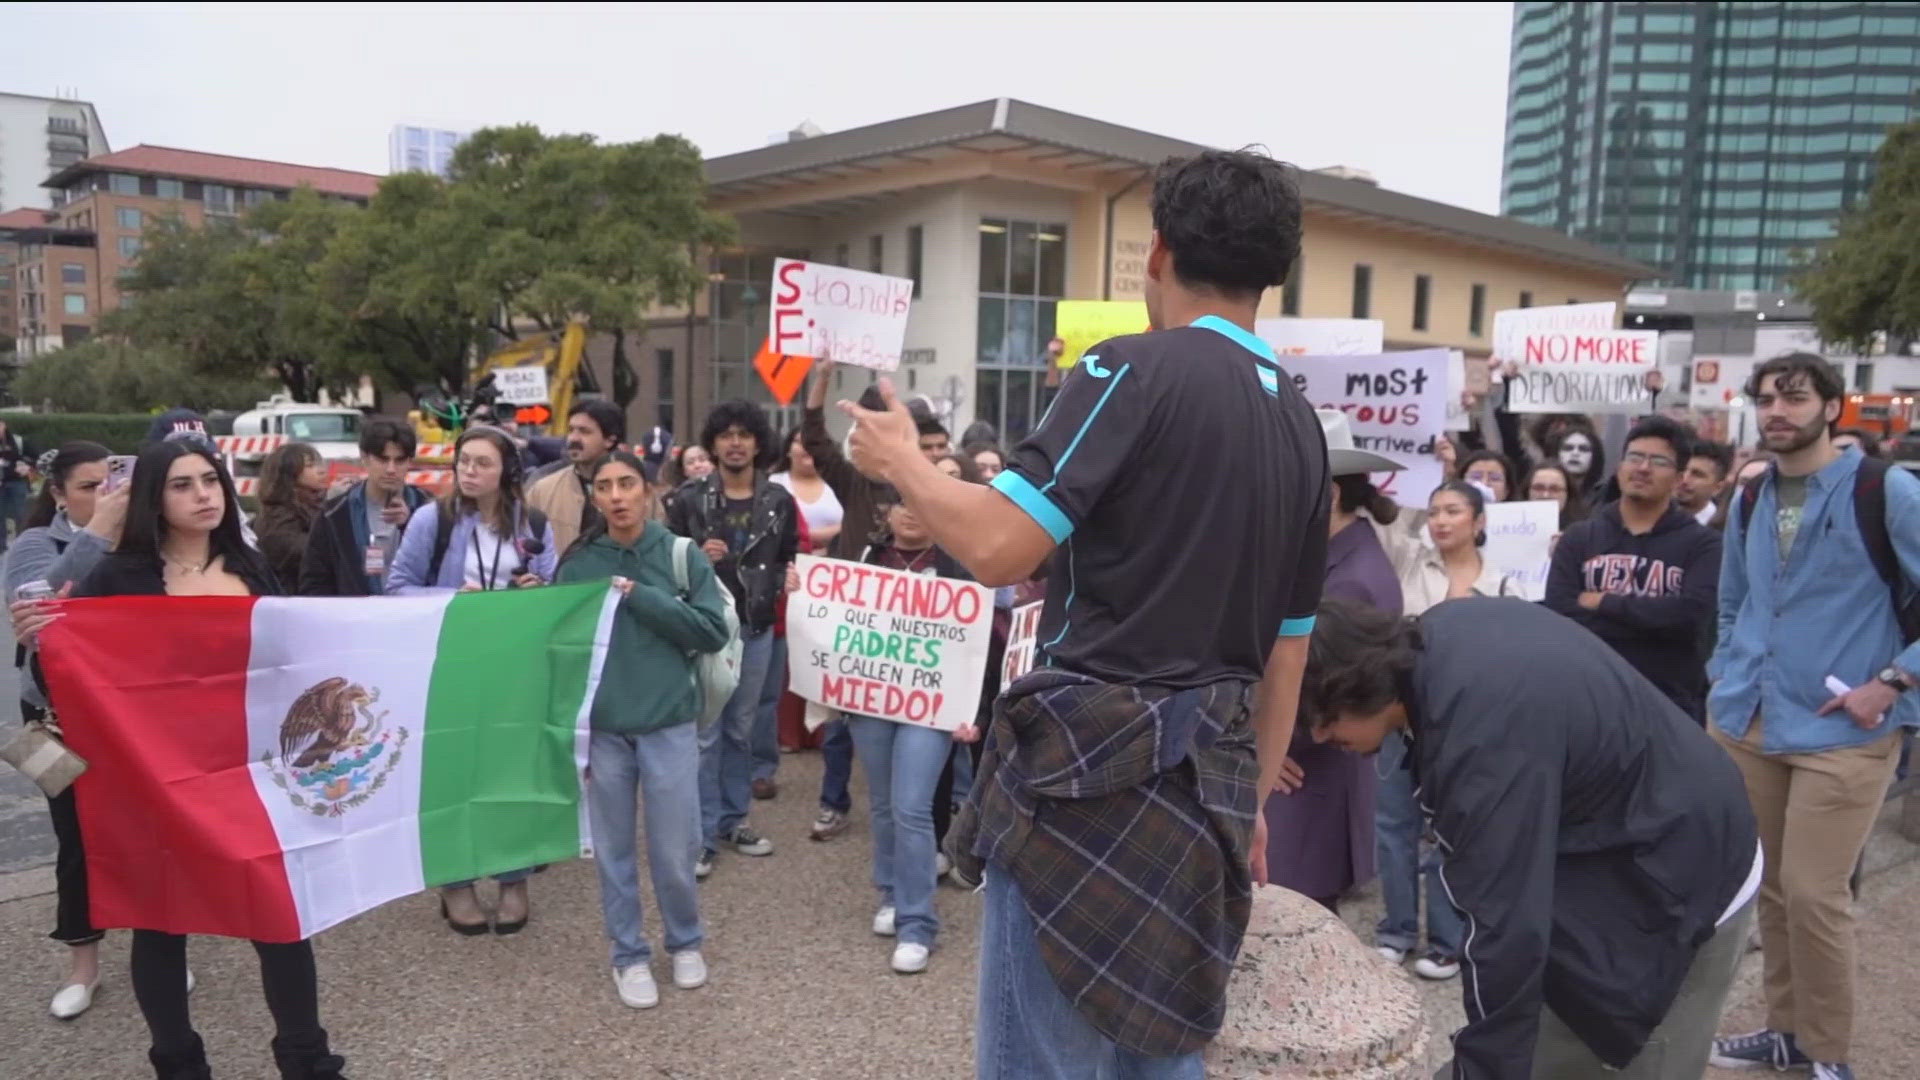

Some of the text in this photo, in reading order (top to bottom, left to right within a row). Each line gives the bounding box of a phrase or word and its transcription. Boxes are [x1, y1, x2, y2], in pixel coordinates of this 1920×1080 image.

[1526, 334, 1648, 365] NO MORE
[504, 386, 544, 399] LOSED
[806, 562, 981, 625] GRITANDO
[1581, 552, 1685, 598] TEXAS
[808, 603, 967, 643] LO QUE NUESTROS
[833, 624, 943, 669] PADRES
[811, 650, 943, 689] SE CALLEN POR
[821, 673, 944, 726] MIEDO!
